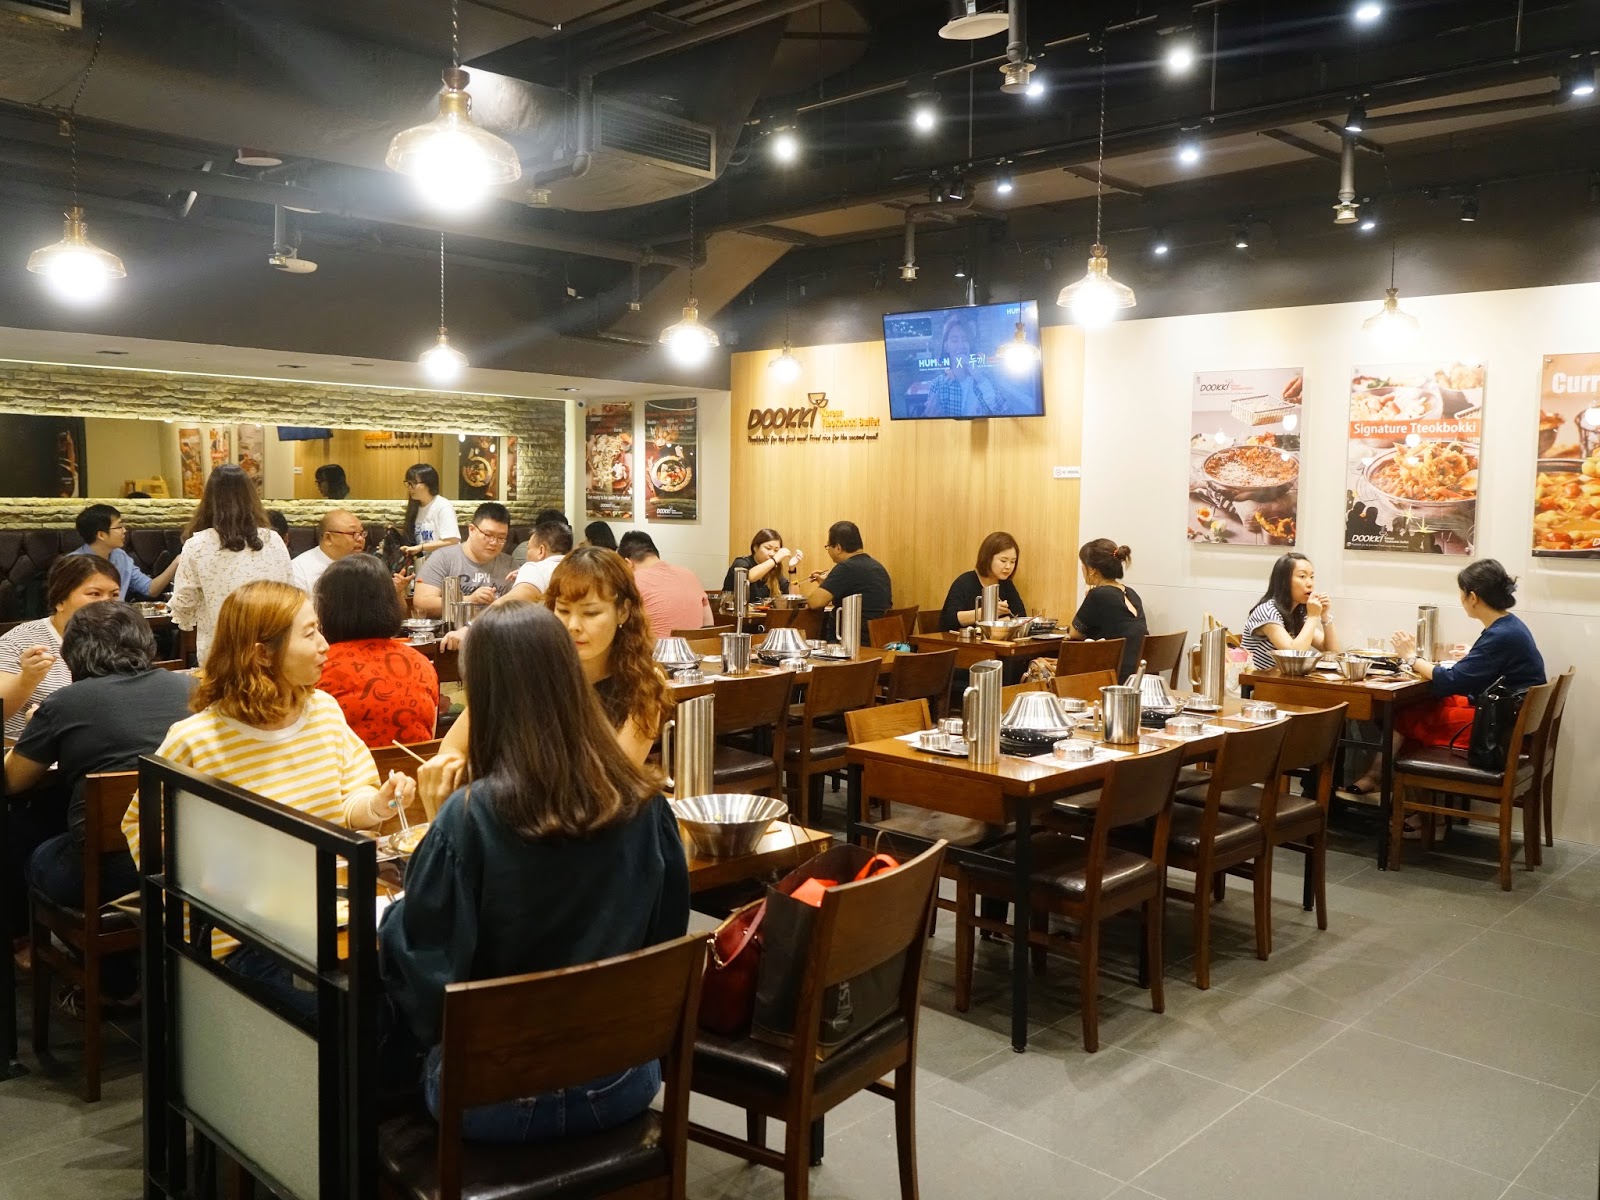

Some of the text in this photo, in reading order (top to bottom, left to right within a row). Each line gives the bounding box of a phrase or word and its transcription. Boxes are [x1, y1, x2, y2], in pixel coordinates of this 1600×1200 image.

[1200, 383, 1230, 392] DOOKKI
[748, 406, 818, 430] DOOKKI
[1353, 422, 1476, 436] Signature Tteokbokki
[472, 572, 490, 583] JPN
